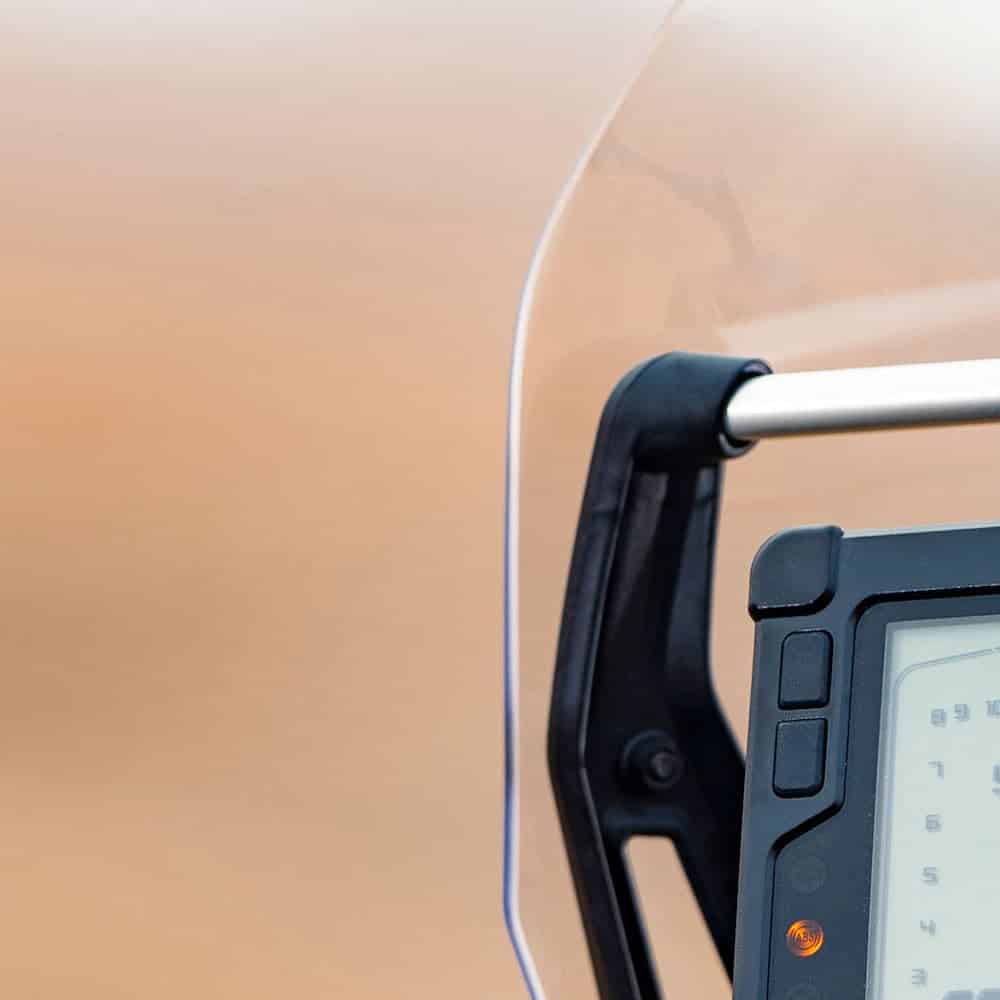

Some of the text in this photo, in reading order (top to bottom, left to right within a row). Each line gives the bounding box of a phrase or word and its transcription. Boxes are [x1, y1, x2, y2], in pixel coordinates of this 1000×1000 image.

[953, 703, 969, 722] 9
[928, 760, 944, 780] 7
[922, 866, 939, 885] 5
[919, 919, 936, 936] 4
[911, 967, 927, 986] 3
